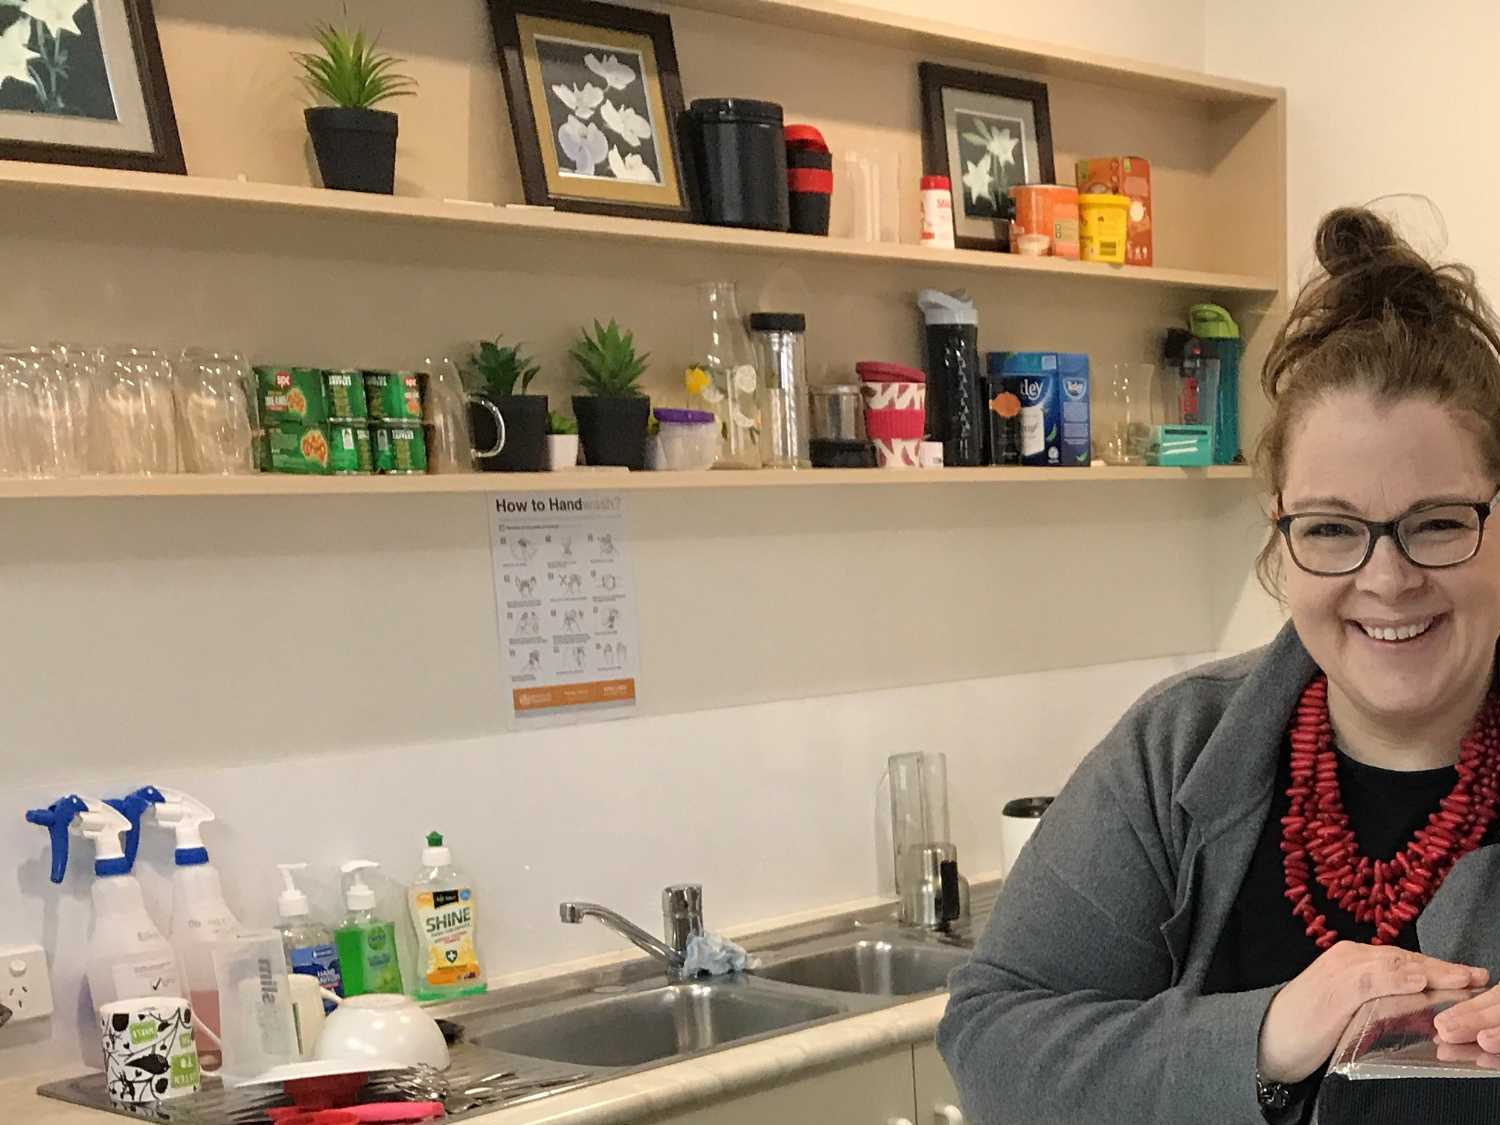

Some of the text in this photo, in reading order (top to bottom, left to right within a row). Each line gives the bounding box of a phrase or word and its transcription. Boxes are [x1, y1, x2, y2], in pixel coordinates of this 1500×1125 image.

[1020, 379, 1044, 401] tley
[496, 499, 528, 513] How
[531, 499, 546, 512] to
[426, 907, 471, 933] SHINE
